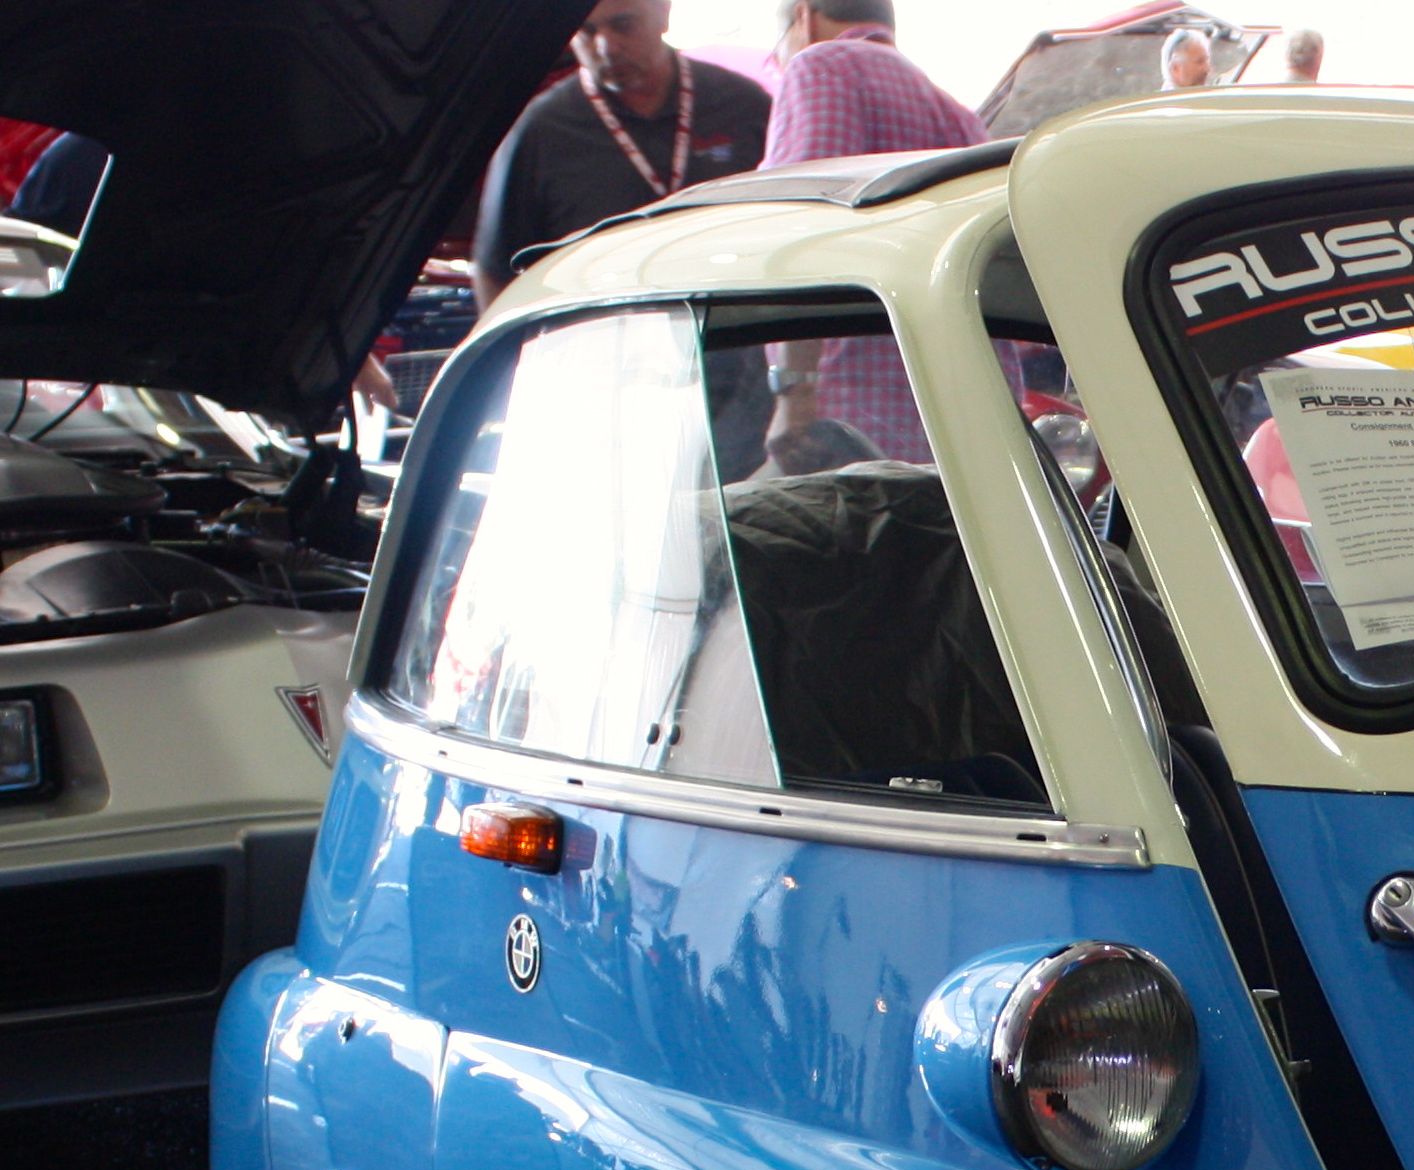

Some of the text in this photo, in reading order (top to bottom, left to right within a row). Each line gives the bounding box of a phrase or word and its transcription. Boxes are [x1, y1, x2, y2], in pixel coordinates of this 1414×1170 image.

[1298, 394, 1385, 409] RUSSO
[1326, 409, 1394, 417] COLLECTOR
[1350, 421, 1413, 433] Consignment
